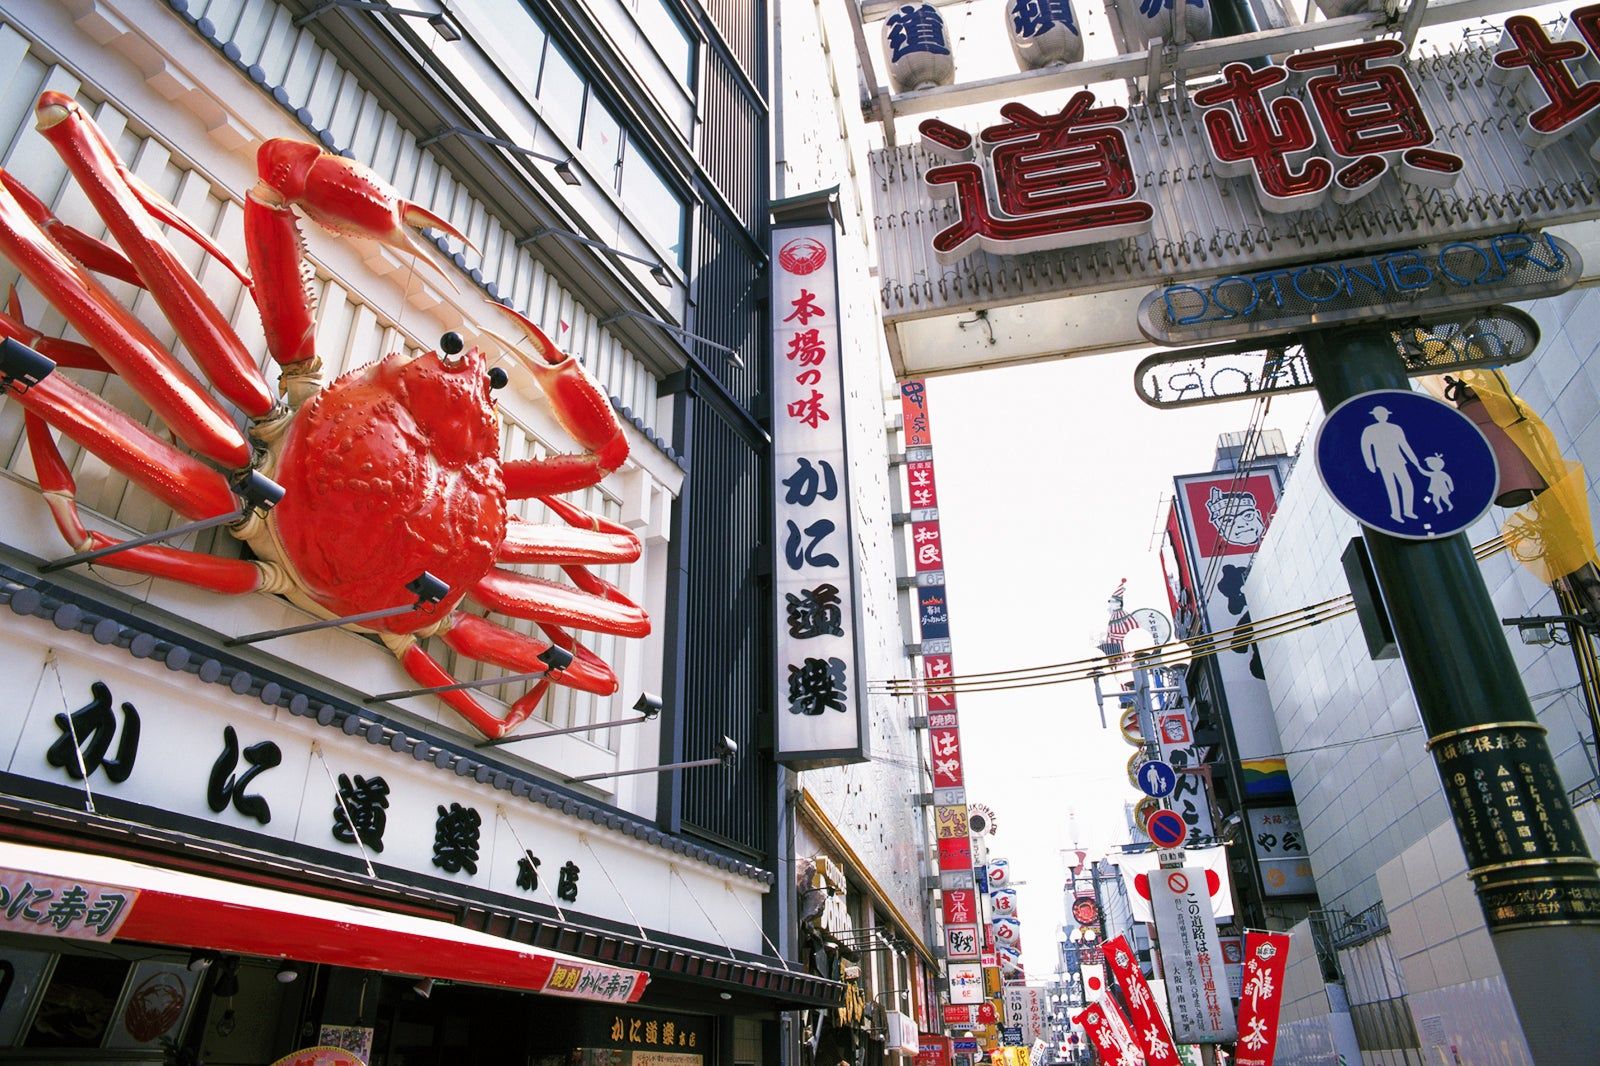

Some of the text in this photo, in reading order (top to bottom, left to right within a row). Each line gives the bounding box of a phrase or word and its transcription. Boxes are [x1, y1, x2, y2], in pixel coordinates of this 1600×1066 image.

[1164, 231, 1563, 326] DOTONBORI
[783, 289, 831, 429] 本場の味
[914, 526, 942, 564] 和民
[782, 457, 847, 716] かに道楽
[932, 731, 960, 782] はや
[950, 891, 968, 923] 白木屋
[579, 970, 635, 1000] かに寿司
[1187, 892, 1224, 1031] この道路は終日通行禁止
